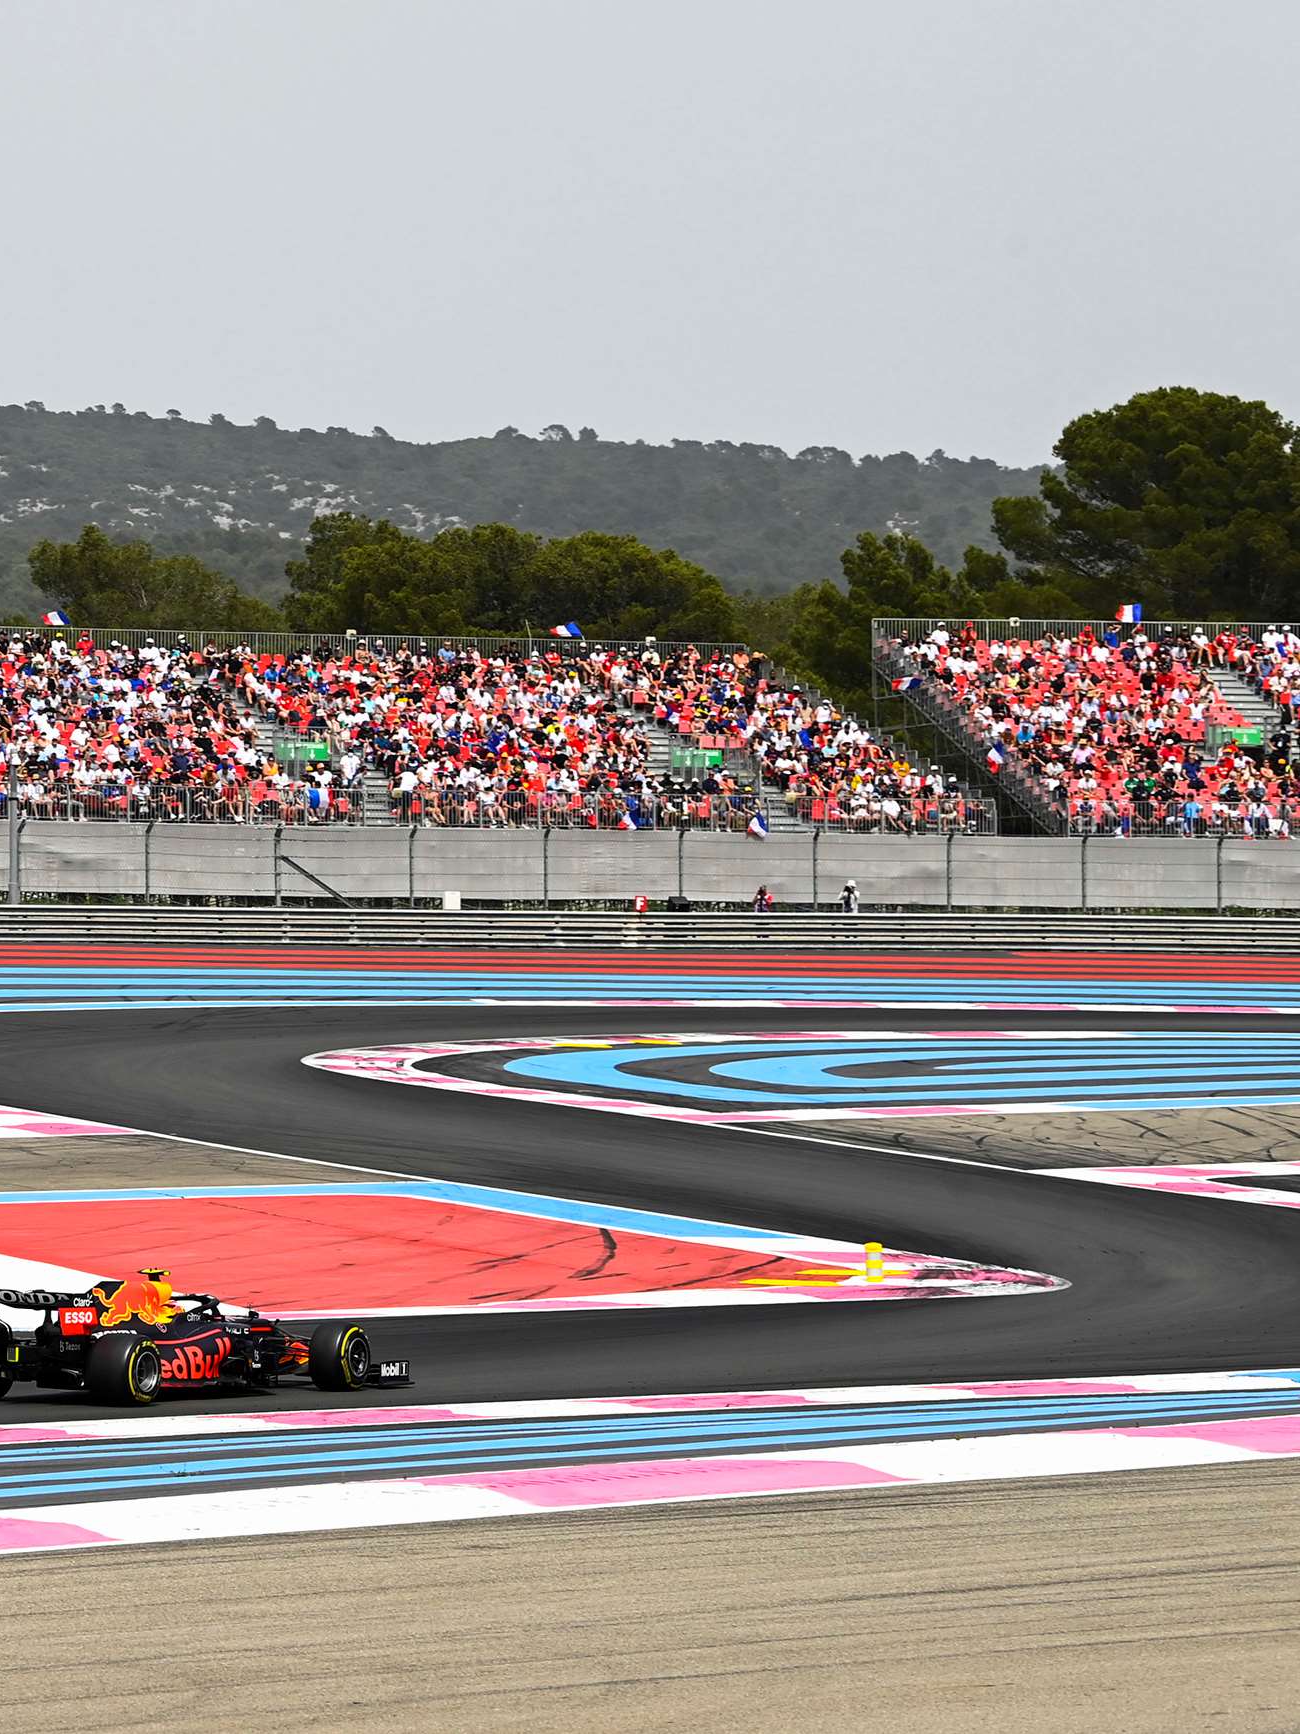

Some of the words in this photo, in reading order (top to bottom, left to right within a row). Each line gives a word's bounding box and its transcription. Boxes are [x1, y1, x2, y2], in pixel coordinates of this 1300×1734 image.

[636, 897, 645, 910] F
[73, 1296, 91, 1307] Claro
[65, 1312, 93, 1324] ESSO
[381, 1362, 400, 1377] Mobil
